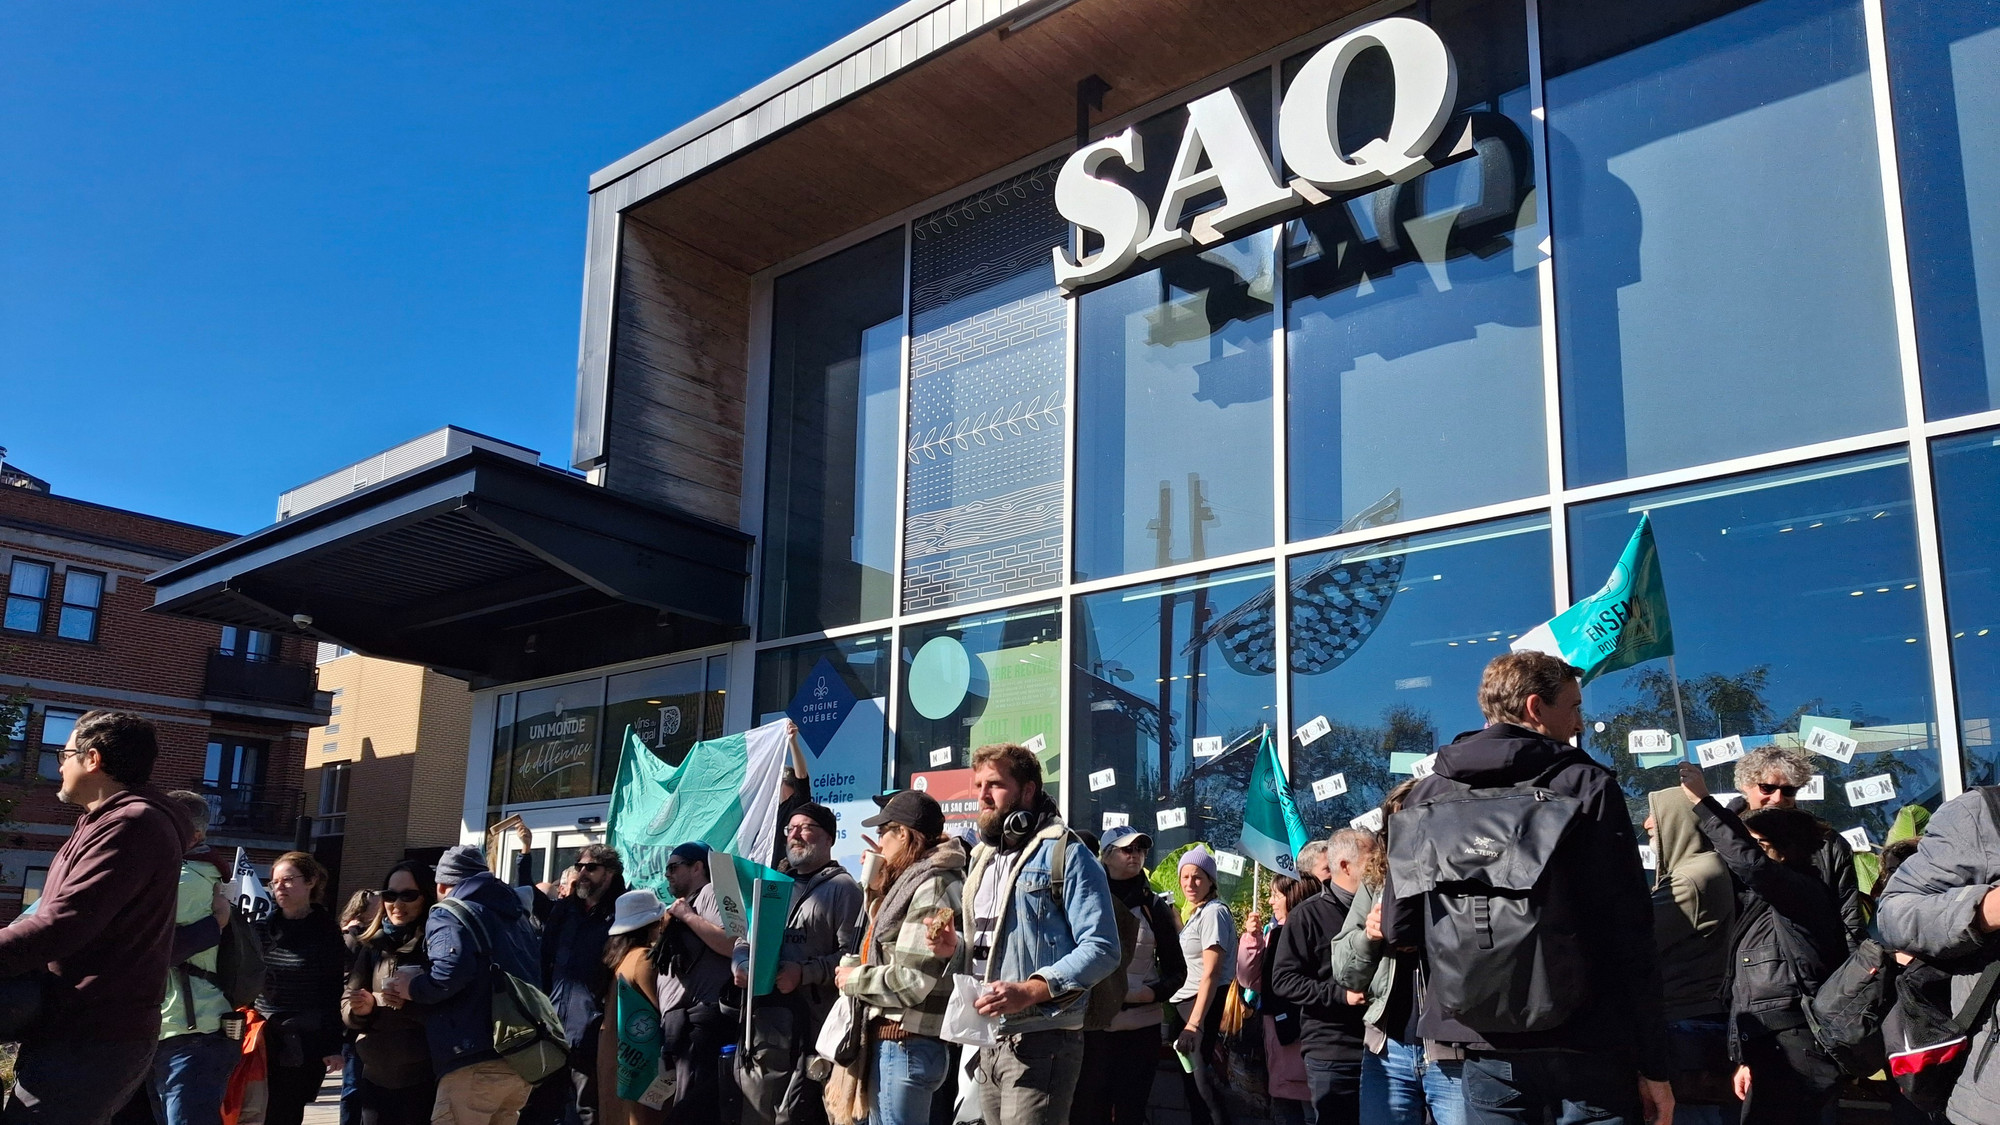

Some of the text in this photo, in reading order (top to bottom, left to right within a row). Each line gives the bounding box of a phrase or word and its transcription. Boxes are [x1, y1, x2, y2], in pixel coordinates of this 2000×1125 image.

[1053, 17, 1458, 292] SAQ
[802, 701, 838, 713] ORIGINE
[802, 712, 838, 724] QUÉBEC
[1021, 713, 1053, 737] MUR
[529, 718, 586, 740] UN MONDE
[1302, 720, 1326, 740] NON
[1634, 734, 1666, 748] NON
[1811, 732, 1850, 756] NON
[1703, 741, 1737, 761] NON
[813, 773, 855, 788] célèbre
[1852, 779, 1892, 800] NON
[811, 792, 854, 805] oir-faire
[941, 803, 949, 813] LA
[950, 802, 963, 813] SAQ
[237, 868, 254, 878] CSN
